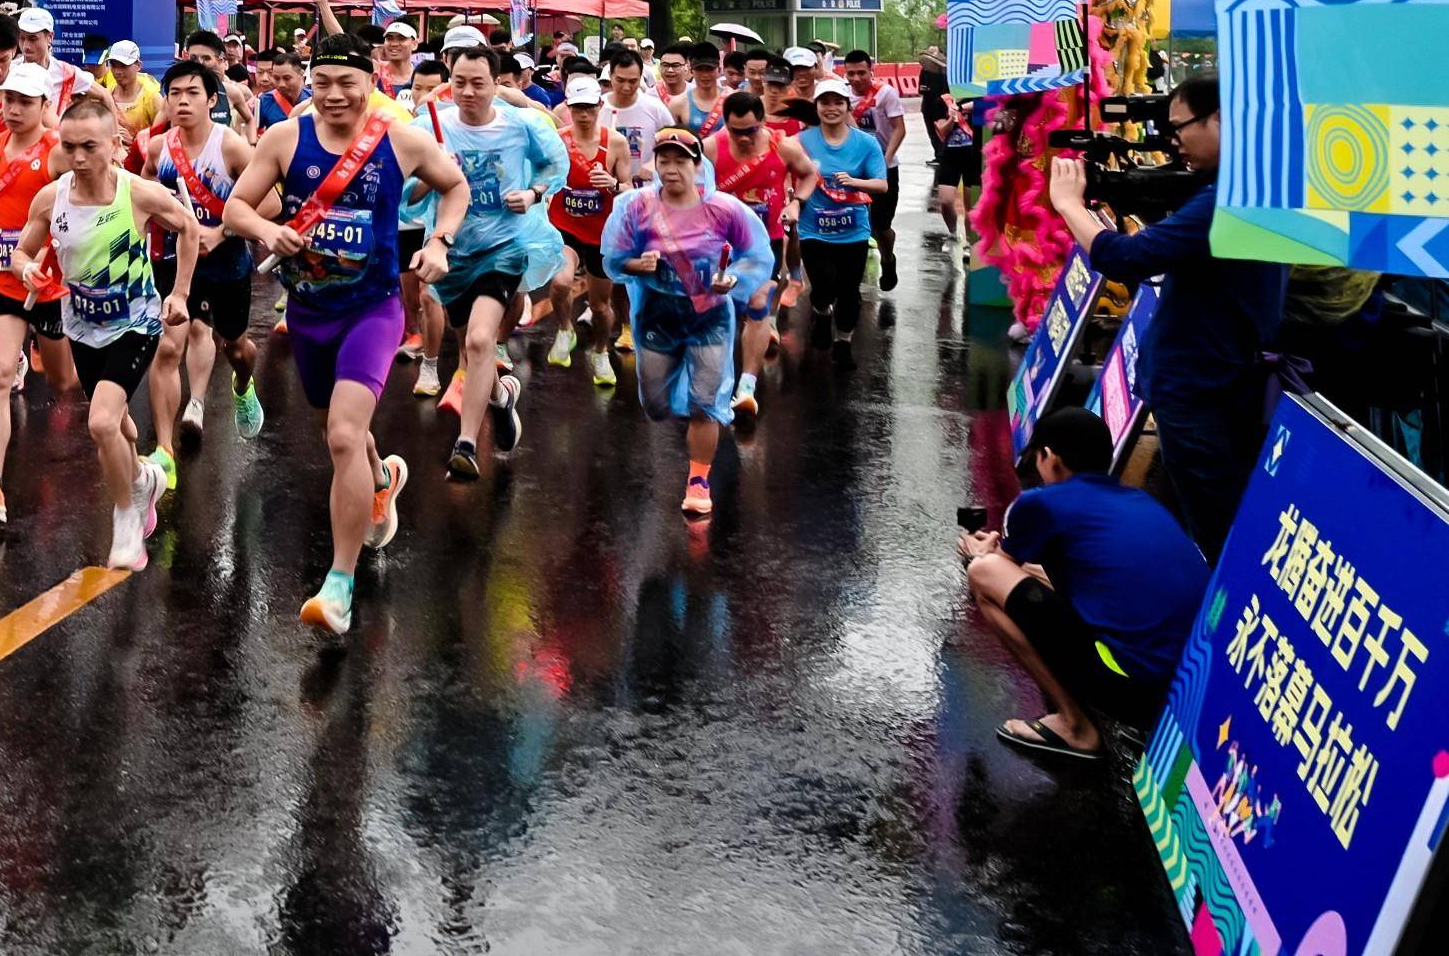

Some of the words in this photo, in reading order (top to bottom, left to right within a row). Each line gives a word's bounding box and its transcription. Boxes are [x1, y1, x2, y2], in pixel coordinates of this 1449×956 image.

[846, 0, 861, 9] POLICE
[818, 215, 852, 228] 058-01
[1263, 503, 1429, 731] 龙腾奋进百千万
[1227, 593, 1379, 850] 永不落幕马拉松
